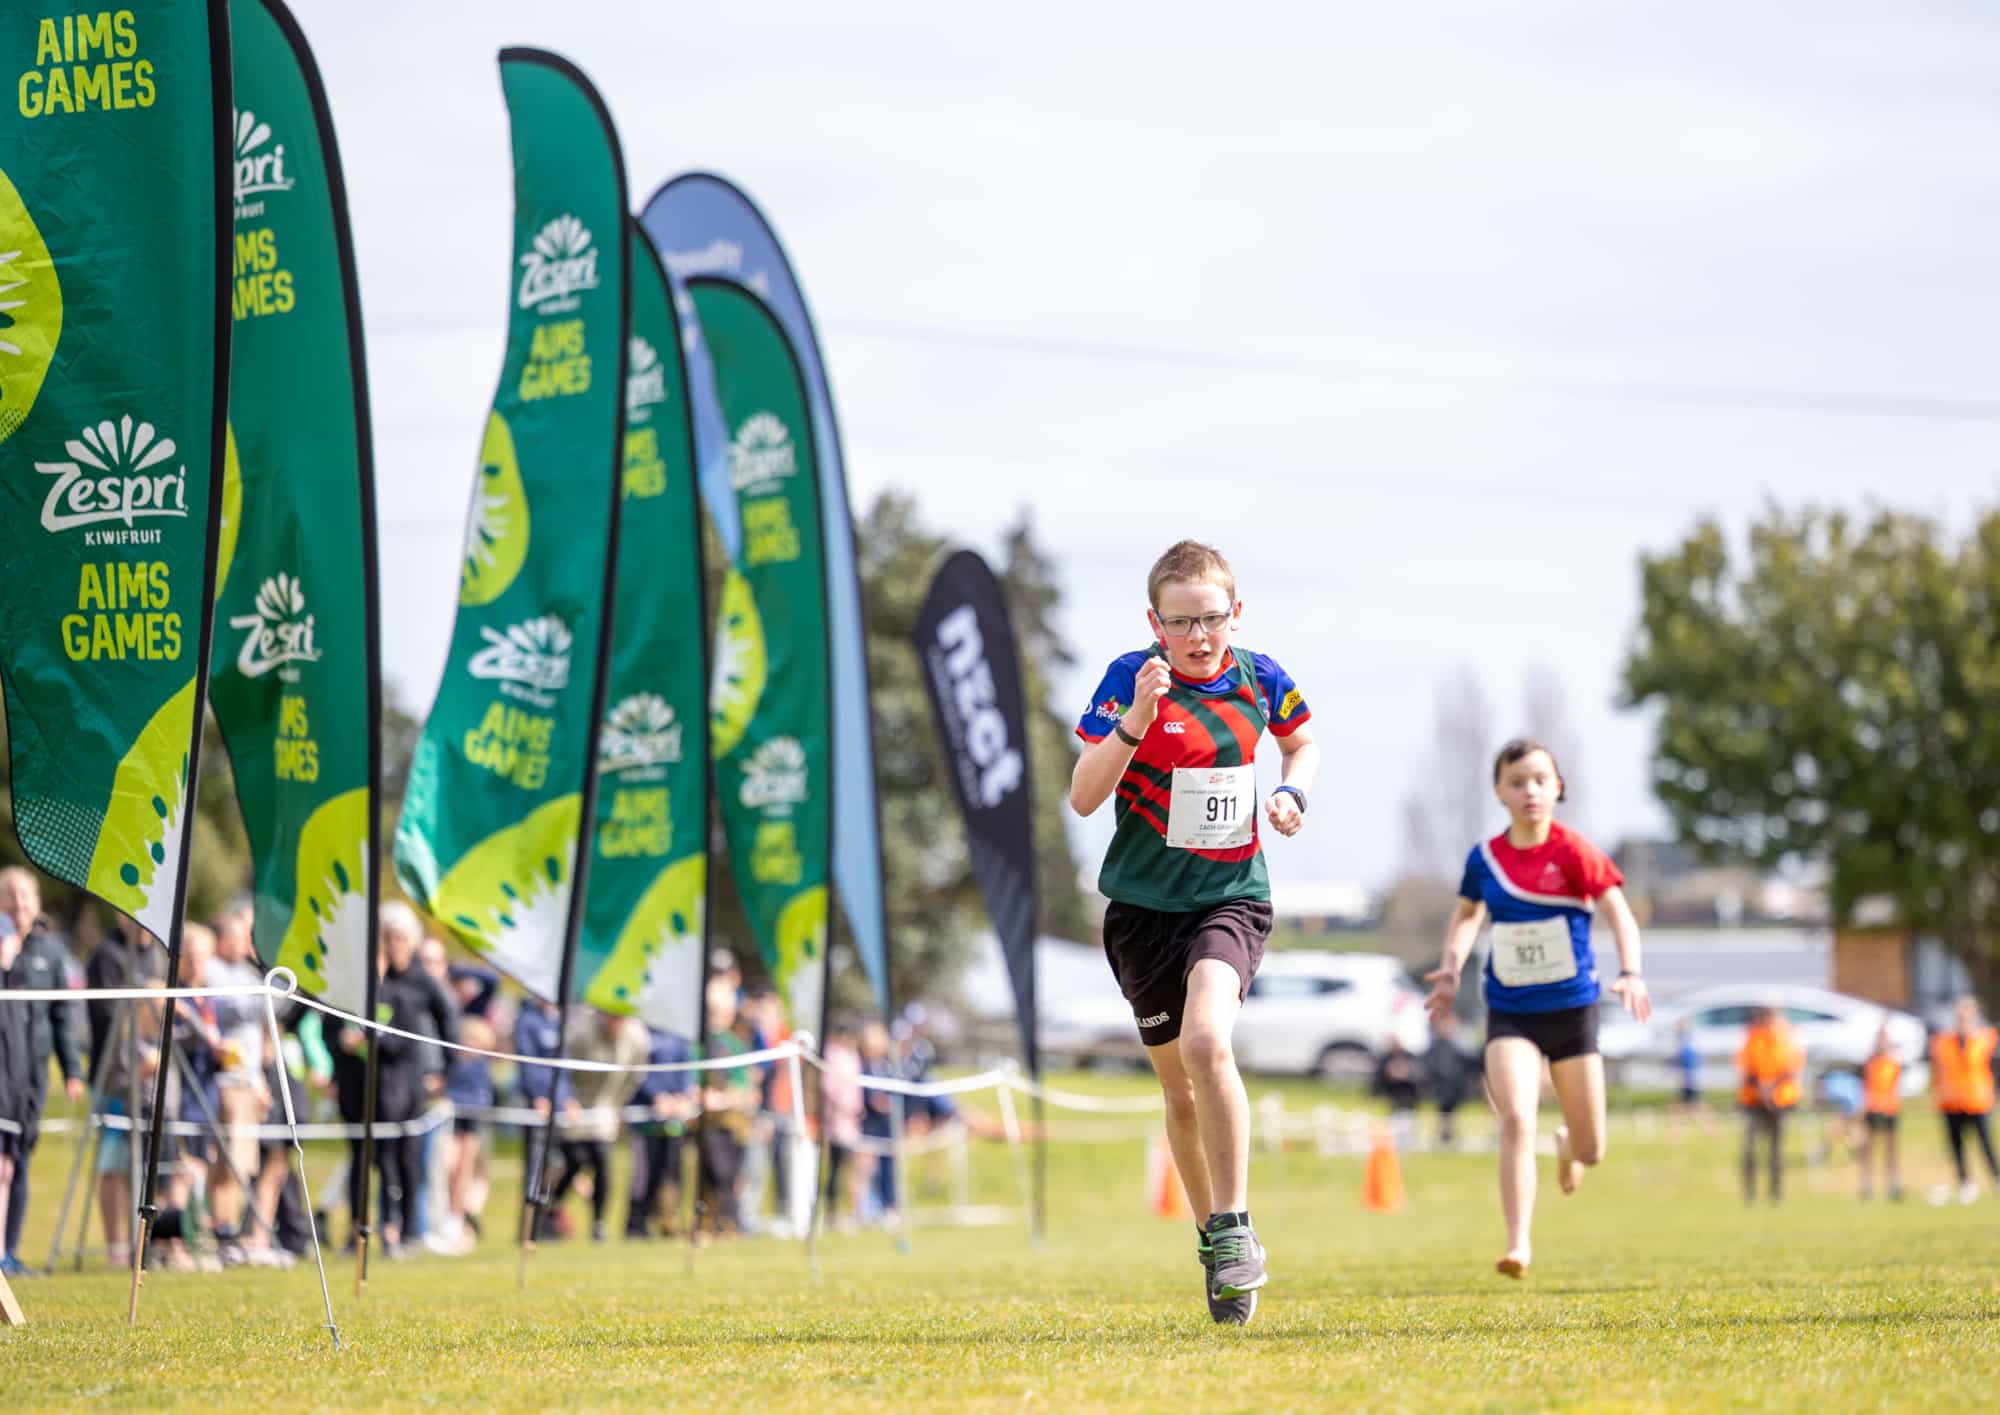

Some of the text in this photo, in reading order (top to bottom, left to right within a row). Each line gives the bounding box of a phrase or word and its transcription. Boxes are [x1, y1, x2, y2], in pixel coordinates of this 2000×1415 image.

[36, 10, 138, 66] AIMS
[18, 60, 156, 118] GAMES
[233, 144, 292, 204] pri
[34, 461, 190, 533] Zespri
[84, 529, 163, 546] KIWIFRUIT
[77, 560, 170, 611] AIMS
[61, 612, 182, 661] GAMES
[1206, 796, 1237, 822] 911
